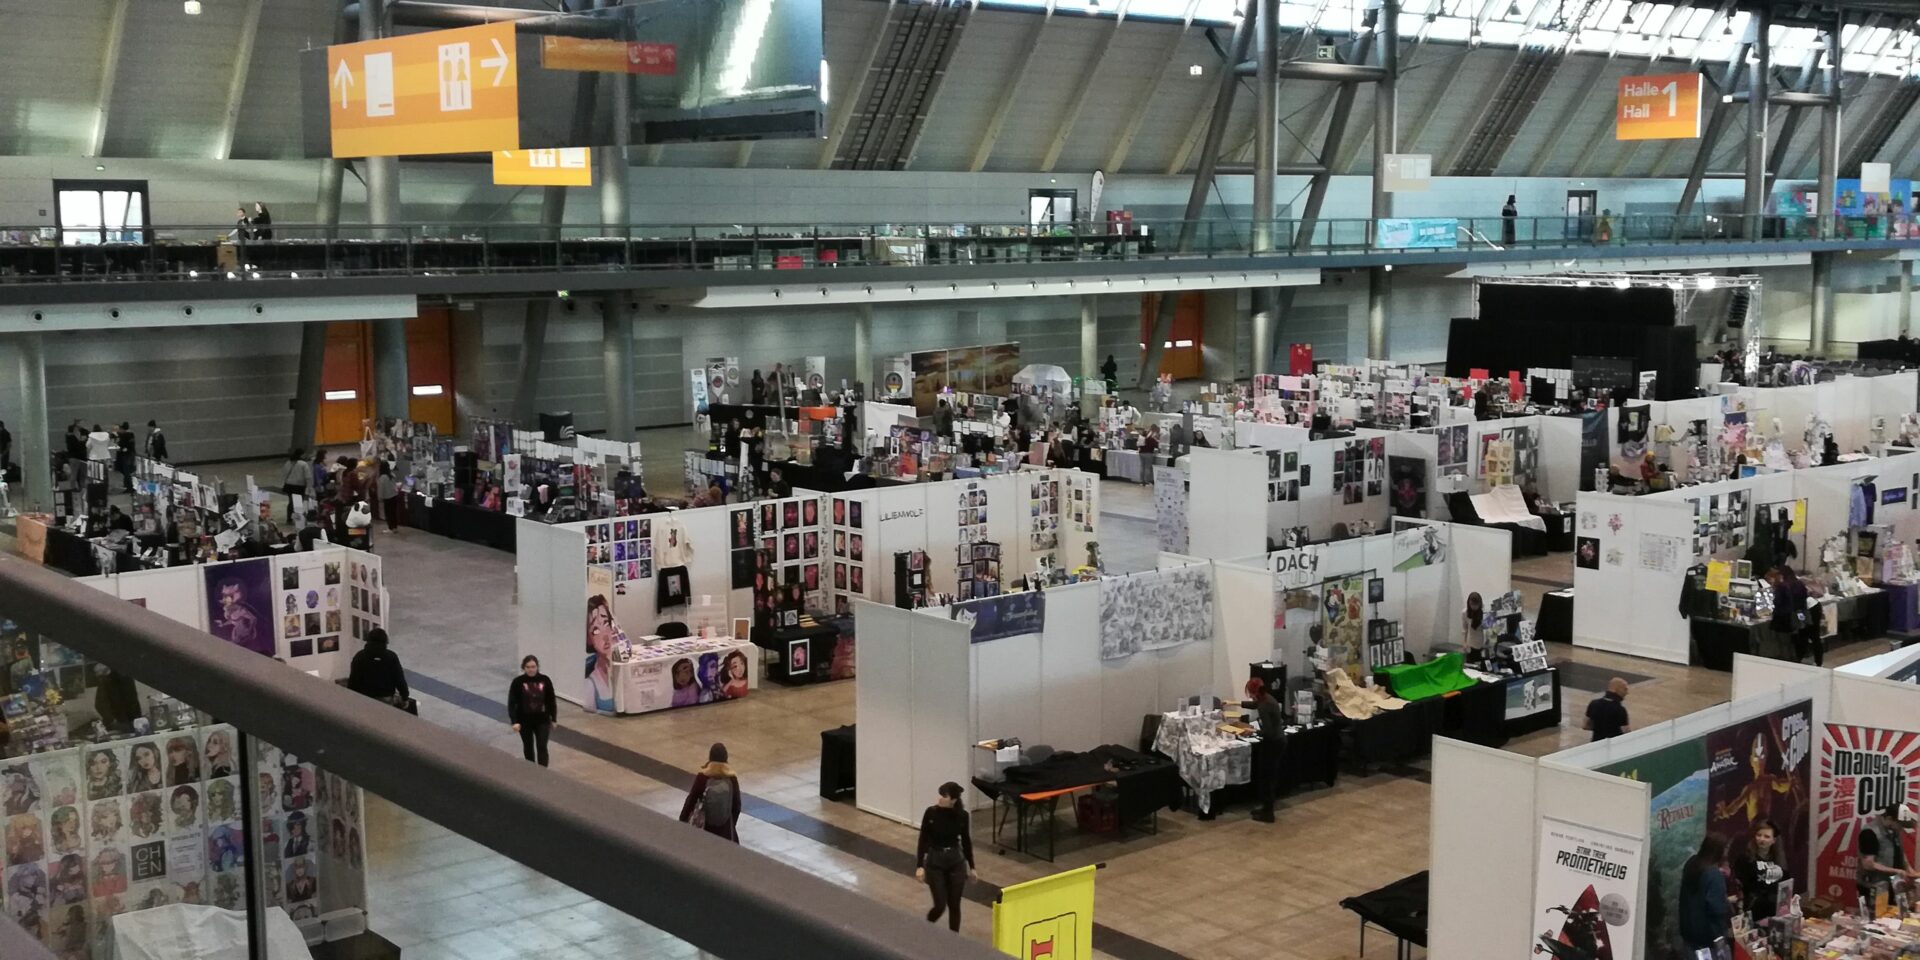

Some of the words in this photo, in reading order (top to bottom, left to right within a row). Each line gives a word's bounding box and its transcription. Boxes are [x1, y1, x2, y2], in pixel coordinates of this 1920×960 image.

[1623, 103, 1650, 118] Hall
[1624, 82, 1659, 97] Halle
[1661, 81, 1677, 117] 1
[1276, 553, 1319, 573] DACH
[1833, 749, 1889, 776] manga
[1857, 767, 1906, 815] cult
[1555, 850, 1628, 880] PROMETHEUS
